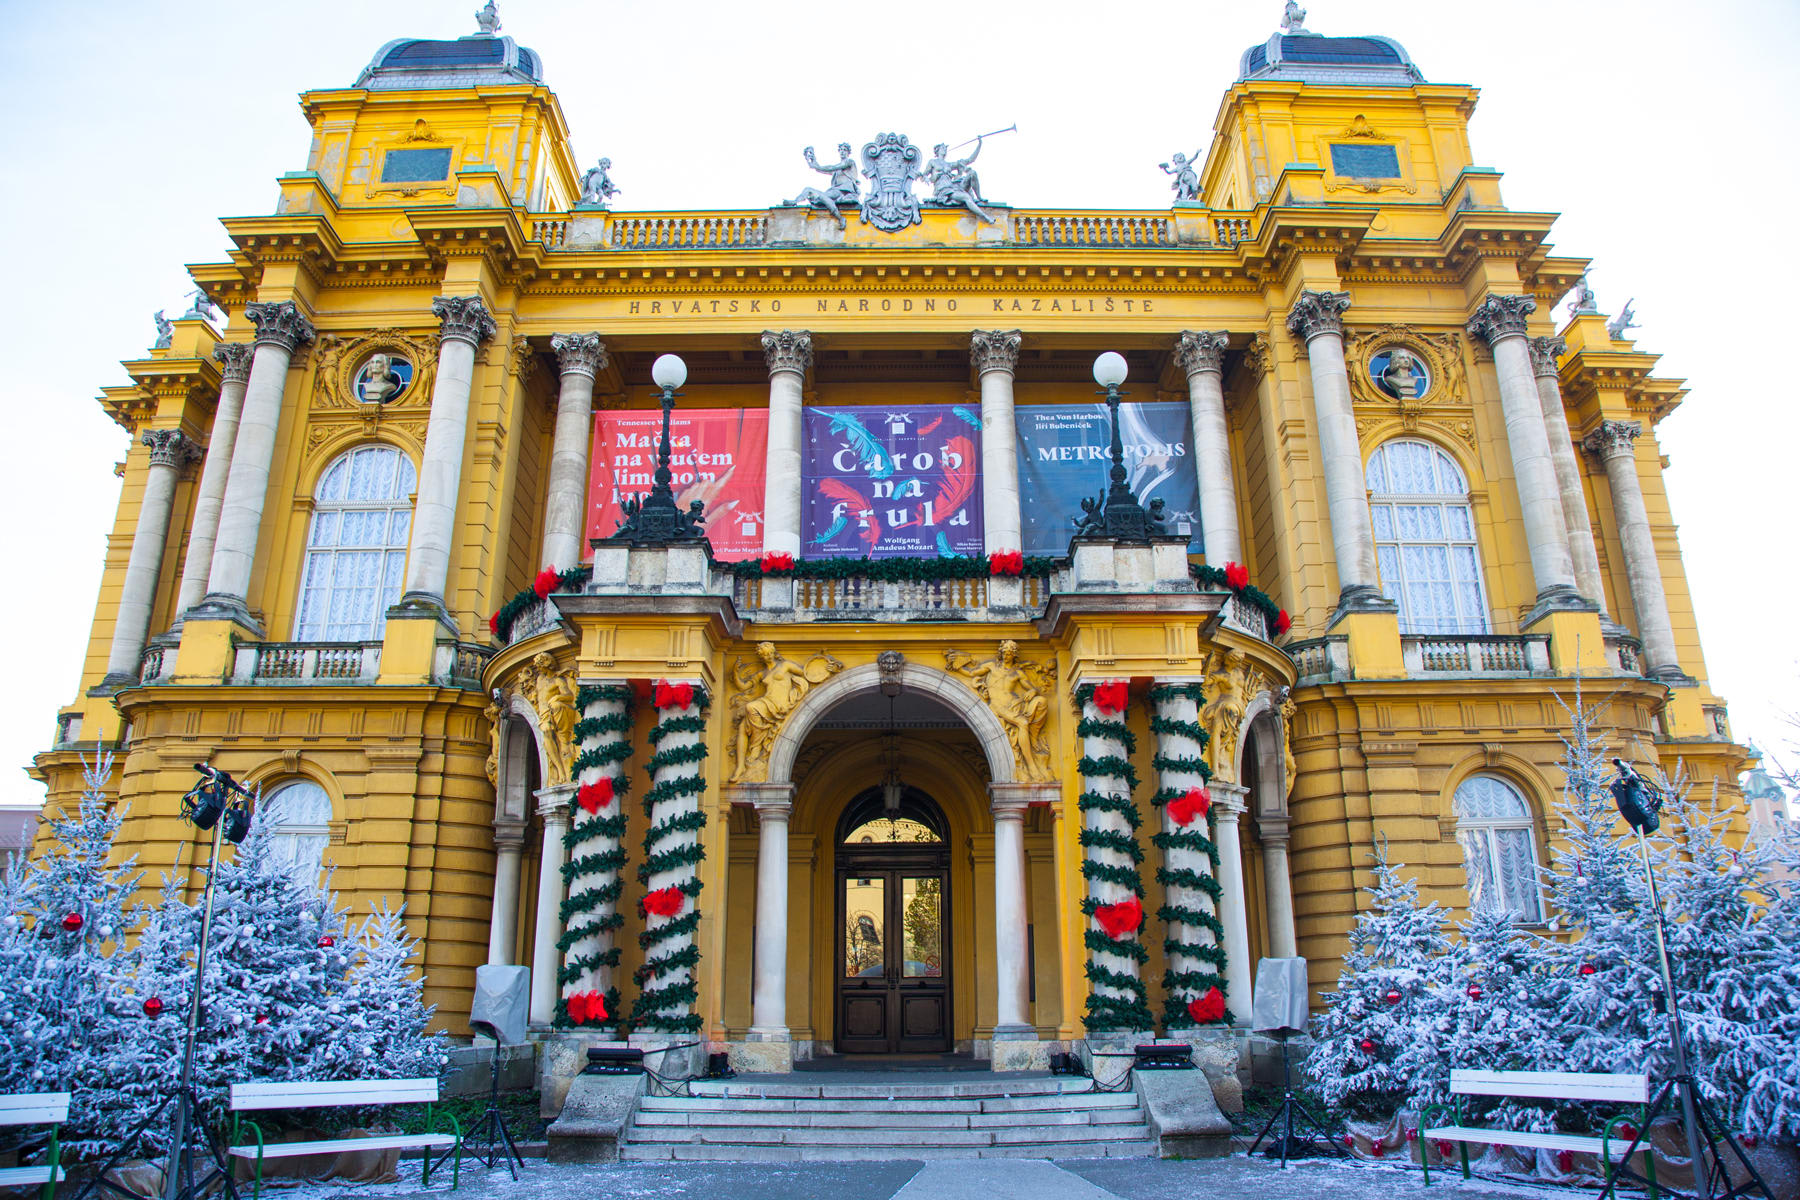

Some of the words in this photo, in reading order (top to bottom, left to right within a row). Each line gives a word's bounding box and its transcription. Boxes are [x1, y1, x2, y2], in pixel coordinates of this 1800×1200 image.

[629, 300, 783, 314] HRVATSKO
[817, 299, 958, 313] NARODNO
[992, 296, 1155, 313] KAZALIŠTE
[616, 419, 656, 427] Tennessee
[657, 418, 691, 426] Wliams
[616, 430, 692, 448] Mačka
[614, 454, 642, 467] na
[648, 448, 733, 466] vućem
[832, 442, 963, 472] Čarob
[1038, 442, 1186, 461] METROPOLIS
[872, 479, 925, 498] na
[831, 501, 970, 528] frula
